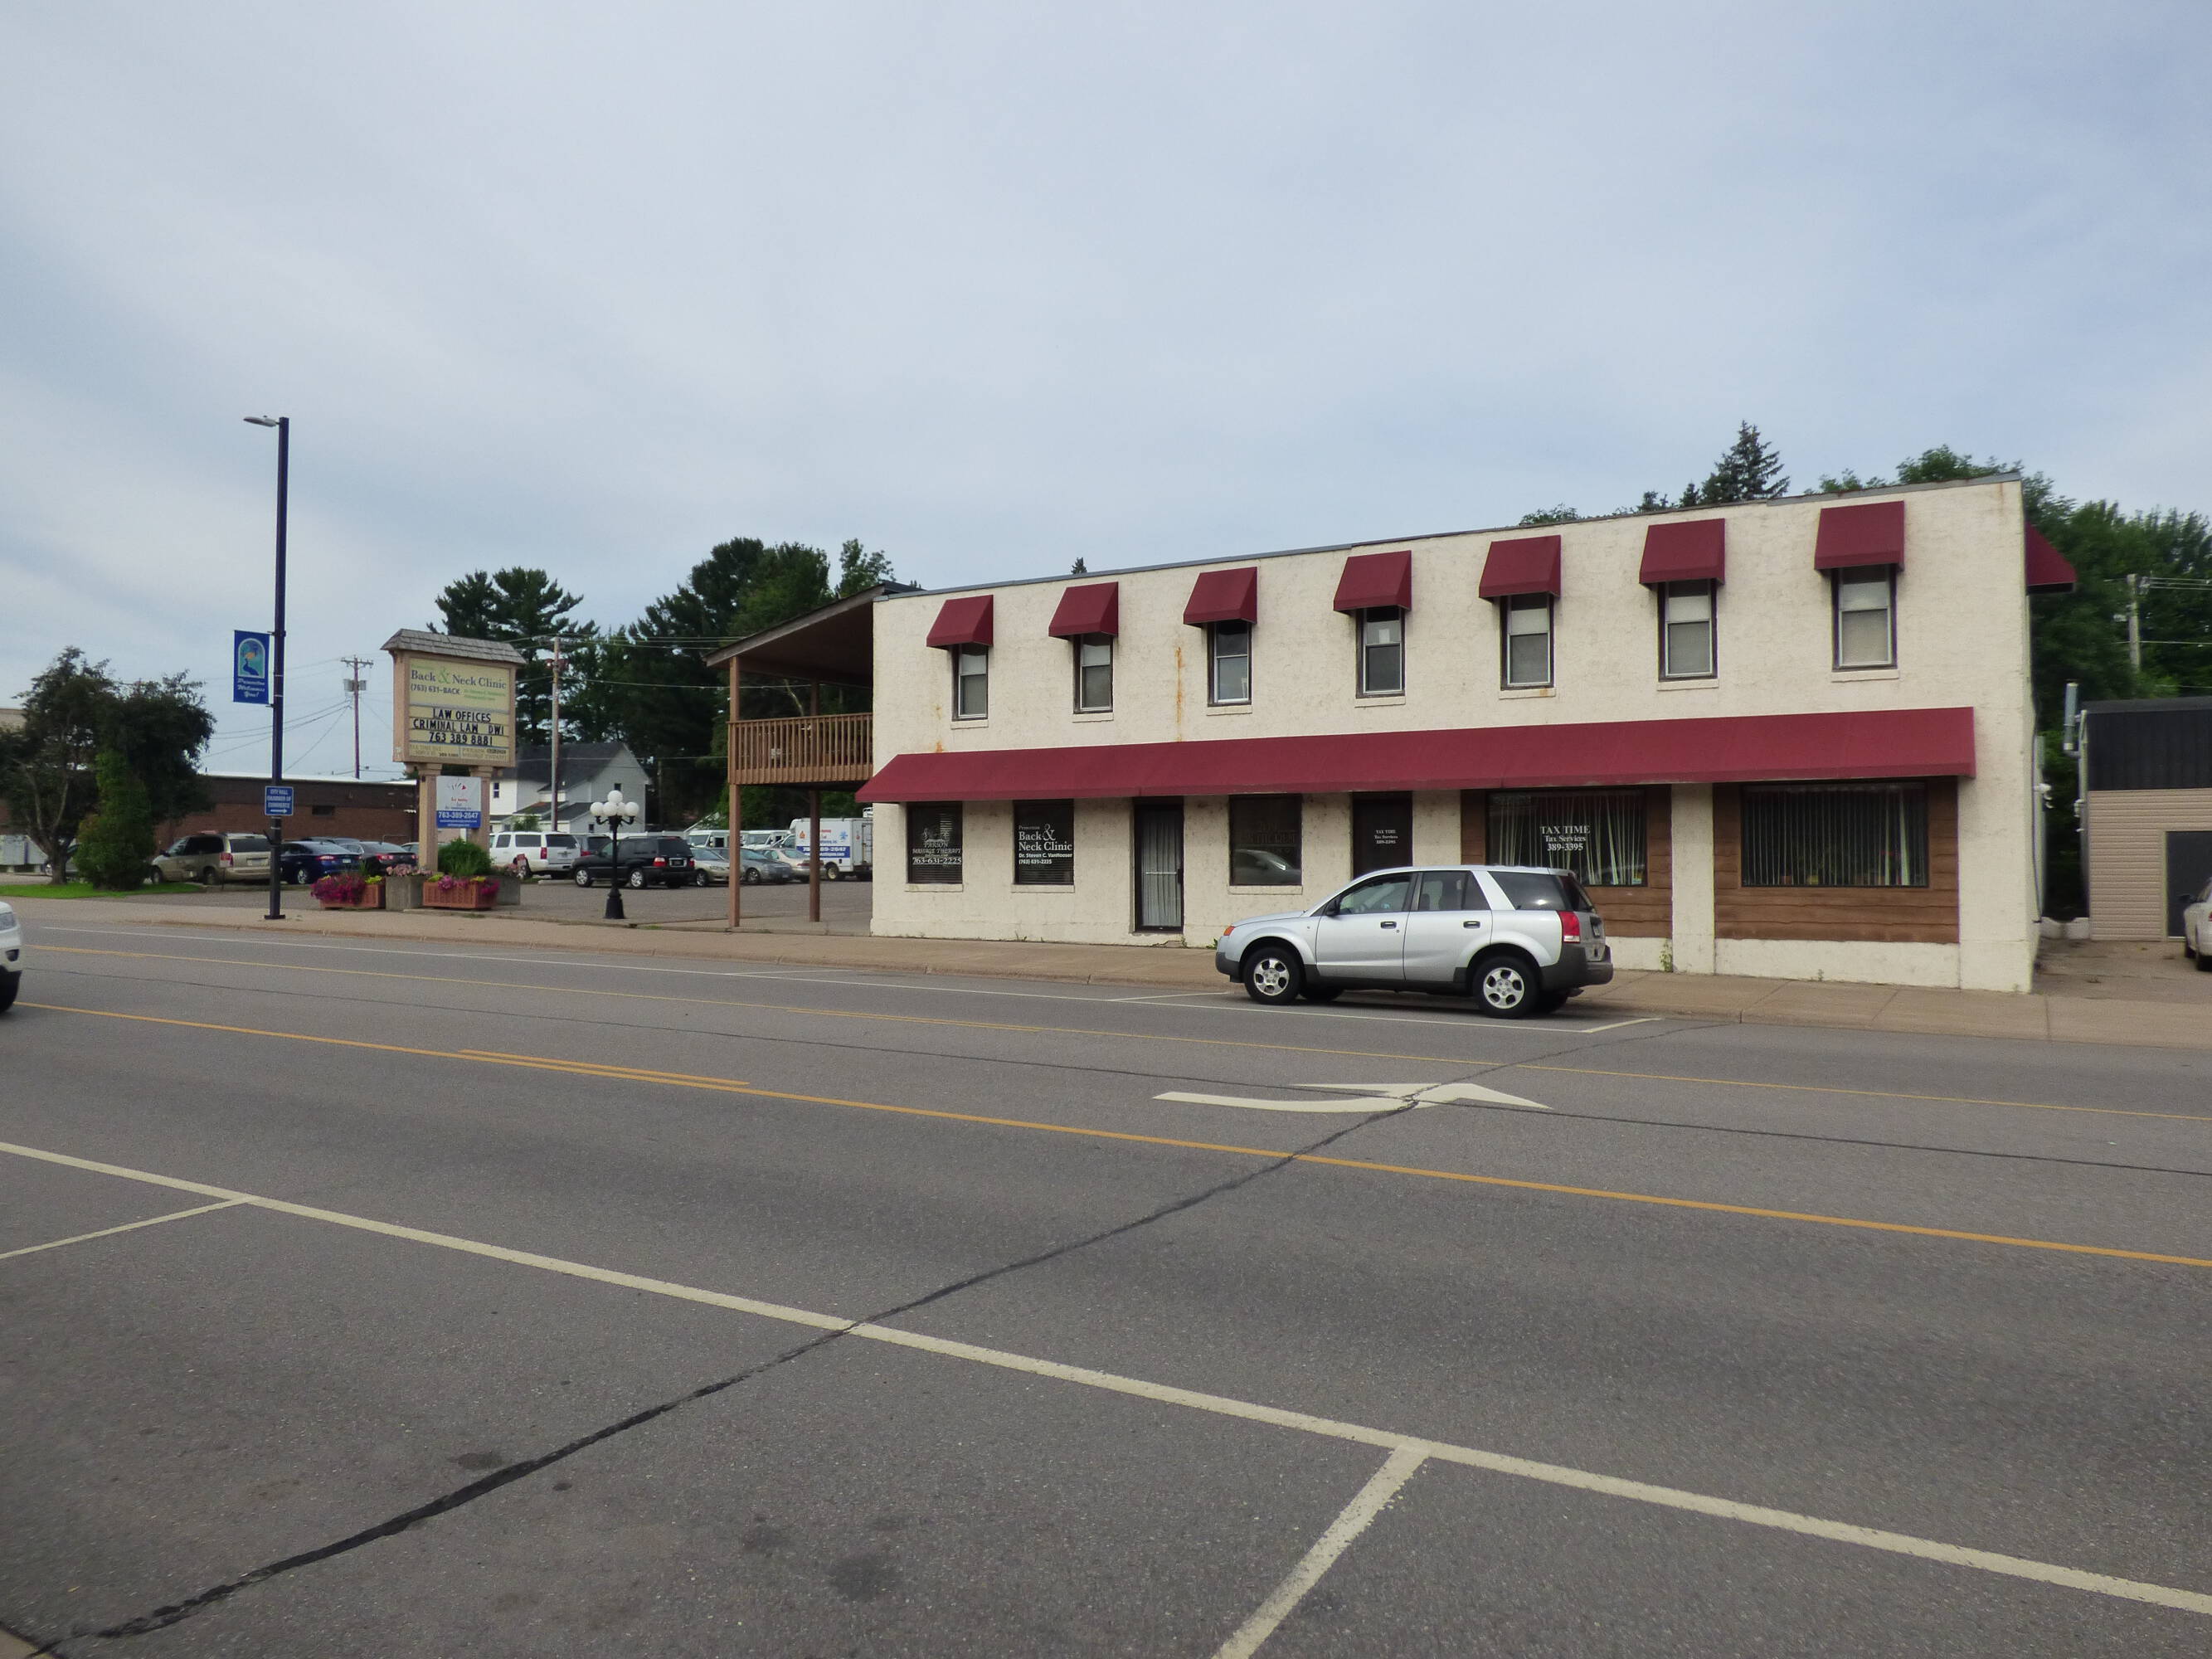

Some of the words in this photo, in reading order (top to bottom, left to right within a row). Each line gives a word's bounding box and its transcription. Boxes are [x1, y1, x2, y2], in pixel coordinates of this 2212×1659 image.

[411, 669, 435, 682] Back
[437, 666, 450, 684] &
[452, 674, 476, 686] Neck
[478, 677, 507, 689] Clinic
[411, 683, 427, 693] (763)
[428, 685, 460, 694] 631-BACK
[432, 708, 452, 720] LAW
[455, 710, 491, 722] OFFICES
[413, 718, 457, 732] CRIMINAL
[459, 722, 479, 734] LAW
[488, 724, 504, 736] DWI
[429, 732, 446, 743] 763
[450, 733, 468, 744] 389
[470, 735, 493, 747] 8881
[1018, 831, 1042, 841] Back
[1043, 823, 1057, 841] &
[1540, 825, 1561, 834] TAX
[1563, 825, 1591, 834] TIME
[1018, 841, 1042, 851] Neck
[1043, 840, 1072, 851] Clinic
[1547, 843, 1583, 851] 389-3395
